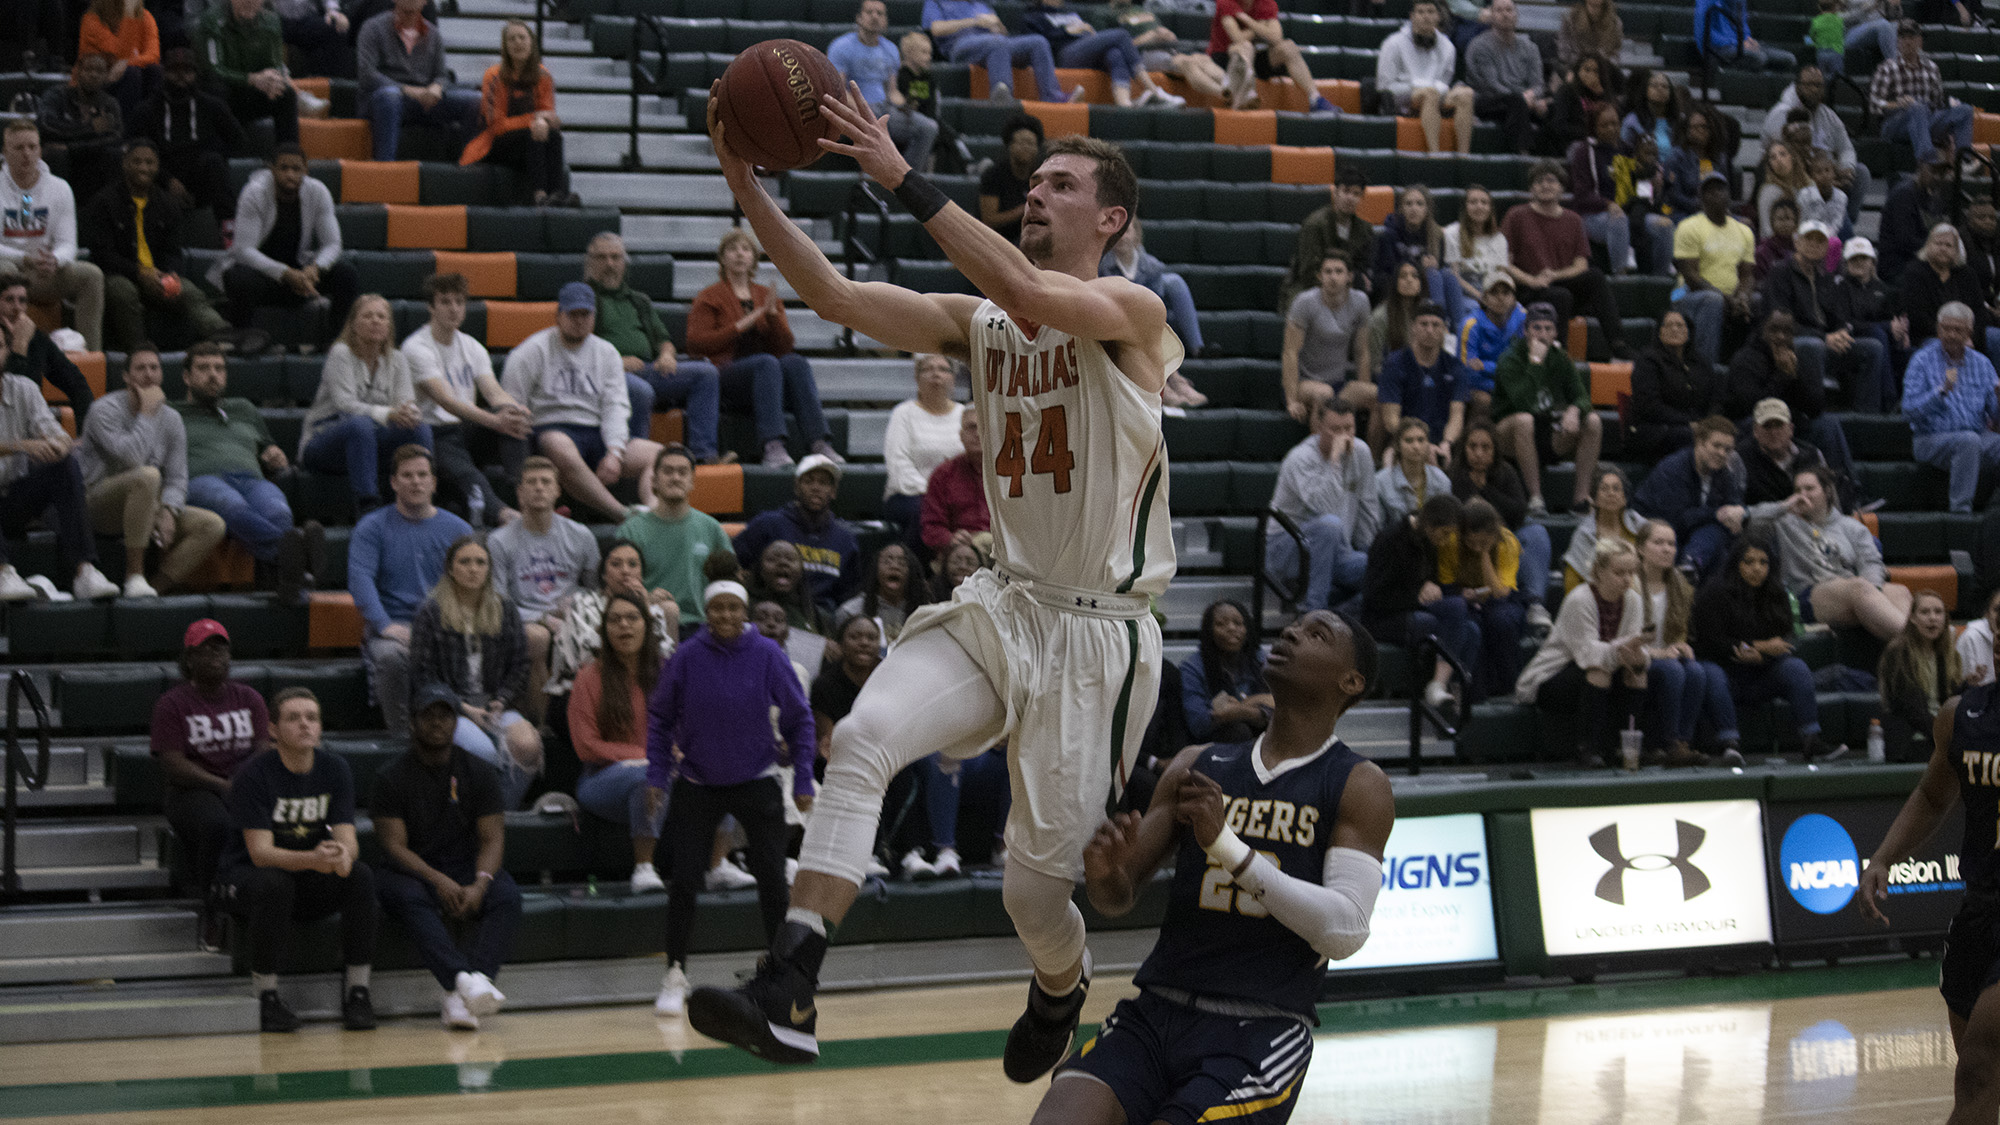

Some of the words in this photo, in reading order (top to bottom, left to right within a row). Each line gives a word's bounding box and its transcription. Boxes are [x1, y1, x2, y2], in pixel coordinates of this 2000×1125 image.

[996, 404, 1075, 498] 44
[1222, 793, 1320, 848] GERS
[1382, 851, 1480, 890] IGNS
[1790, 859, 1859, 890] NCAA
[1575, 922, 1643, 939] UNDER
[1653, 917, 1737, 934] ARMOUR
